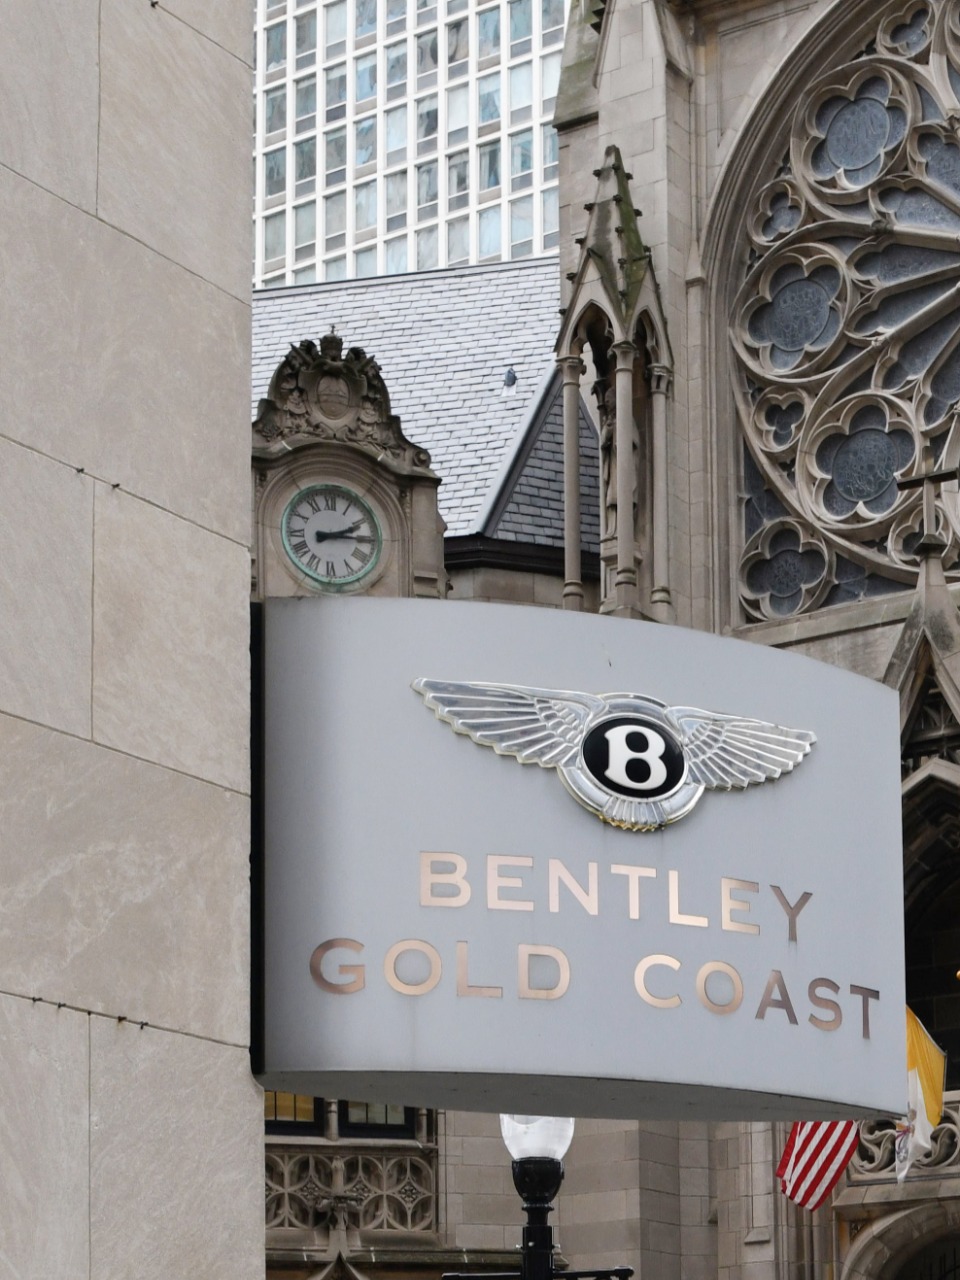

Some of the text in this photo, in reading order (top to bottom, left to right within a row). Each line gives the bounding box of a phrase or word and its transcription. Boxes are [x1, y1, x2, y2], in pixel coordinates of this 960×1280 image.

[603, 724, 667, 791] B
[419, 851, 813, 942] BENTLEY
[309, 937, 880, 1039] GOLD COAST
